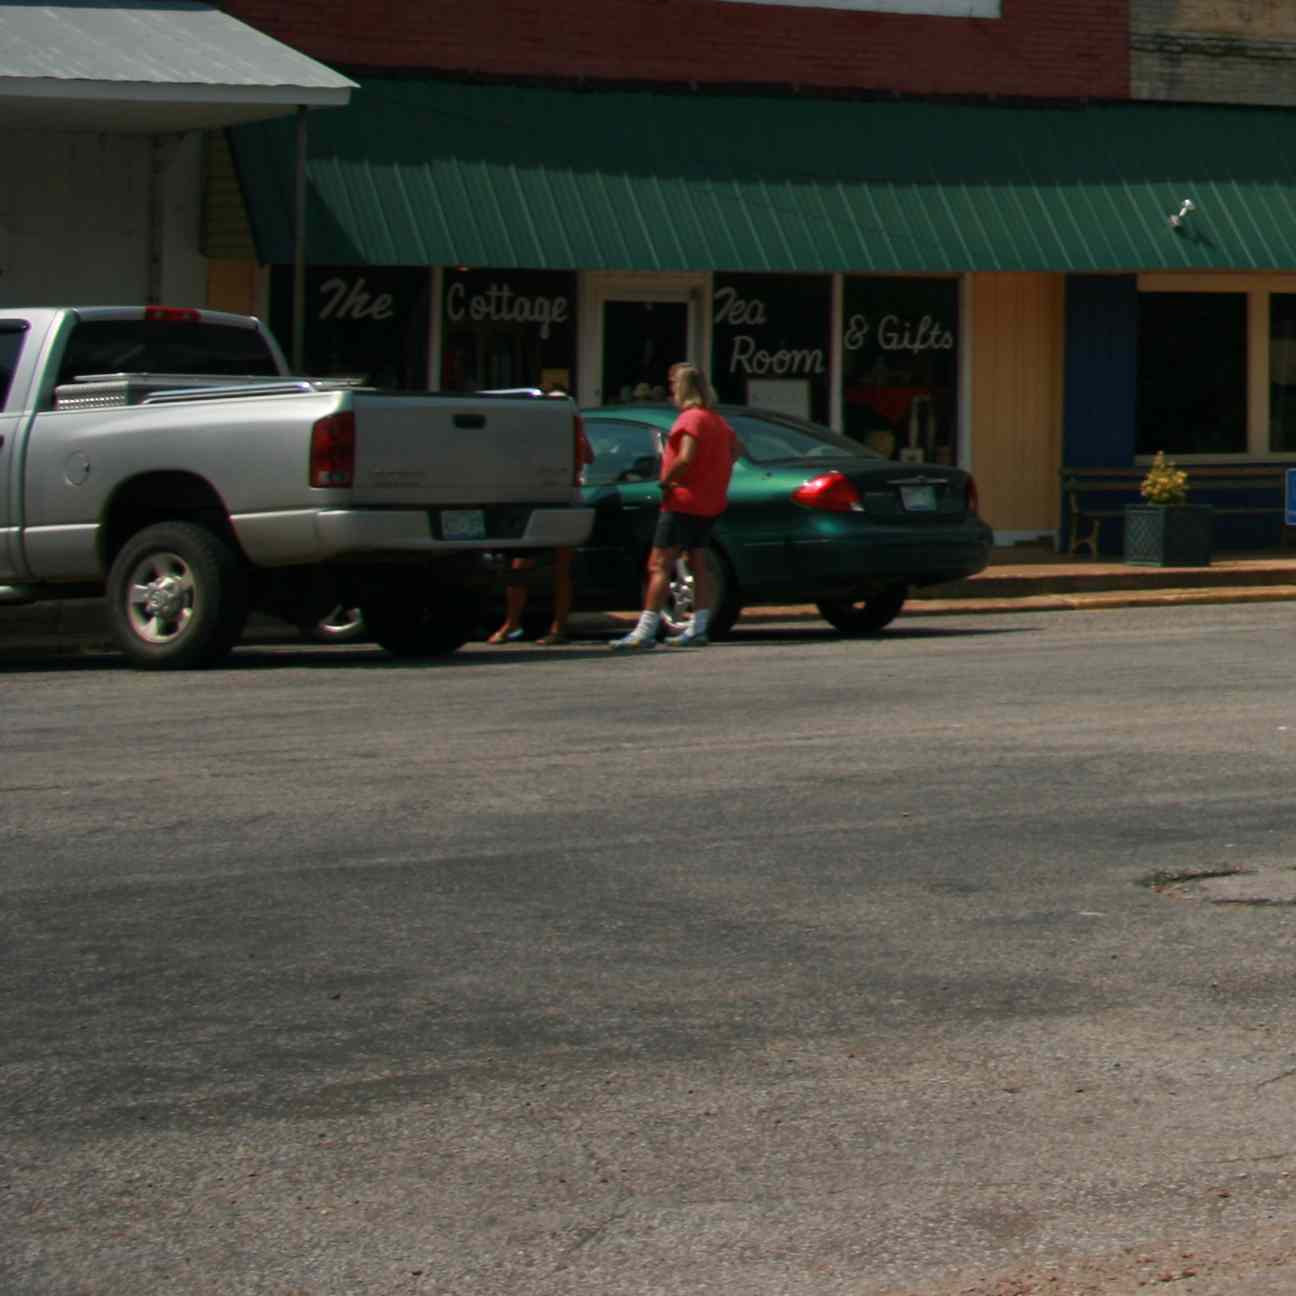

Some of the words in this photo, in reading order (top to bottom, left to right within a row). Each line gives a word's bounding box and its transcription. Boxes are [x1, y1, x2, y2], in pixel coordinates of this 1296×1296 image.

[318, 274, 395, 321] The
[446, 281, 569, 340] Cottage
[713, 285, 768, 326] Tea
[728, 334, 826, 375] Room
[843, 313, 871, 351] &
[877, 313, 954, 355] Gifts
